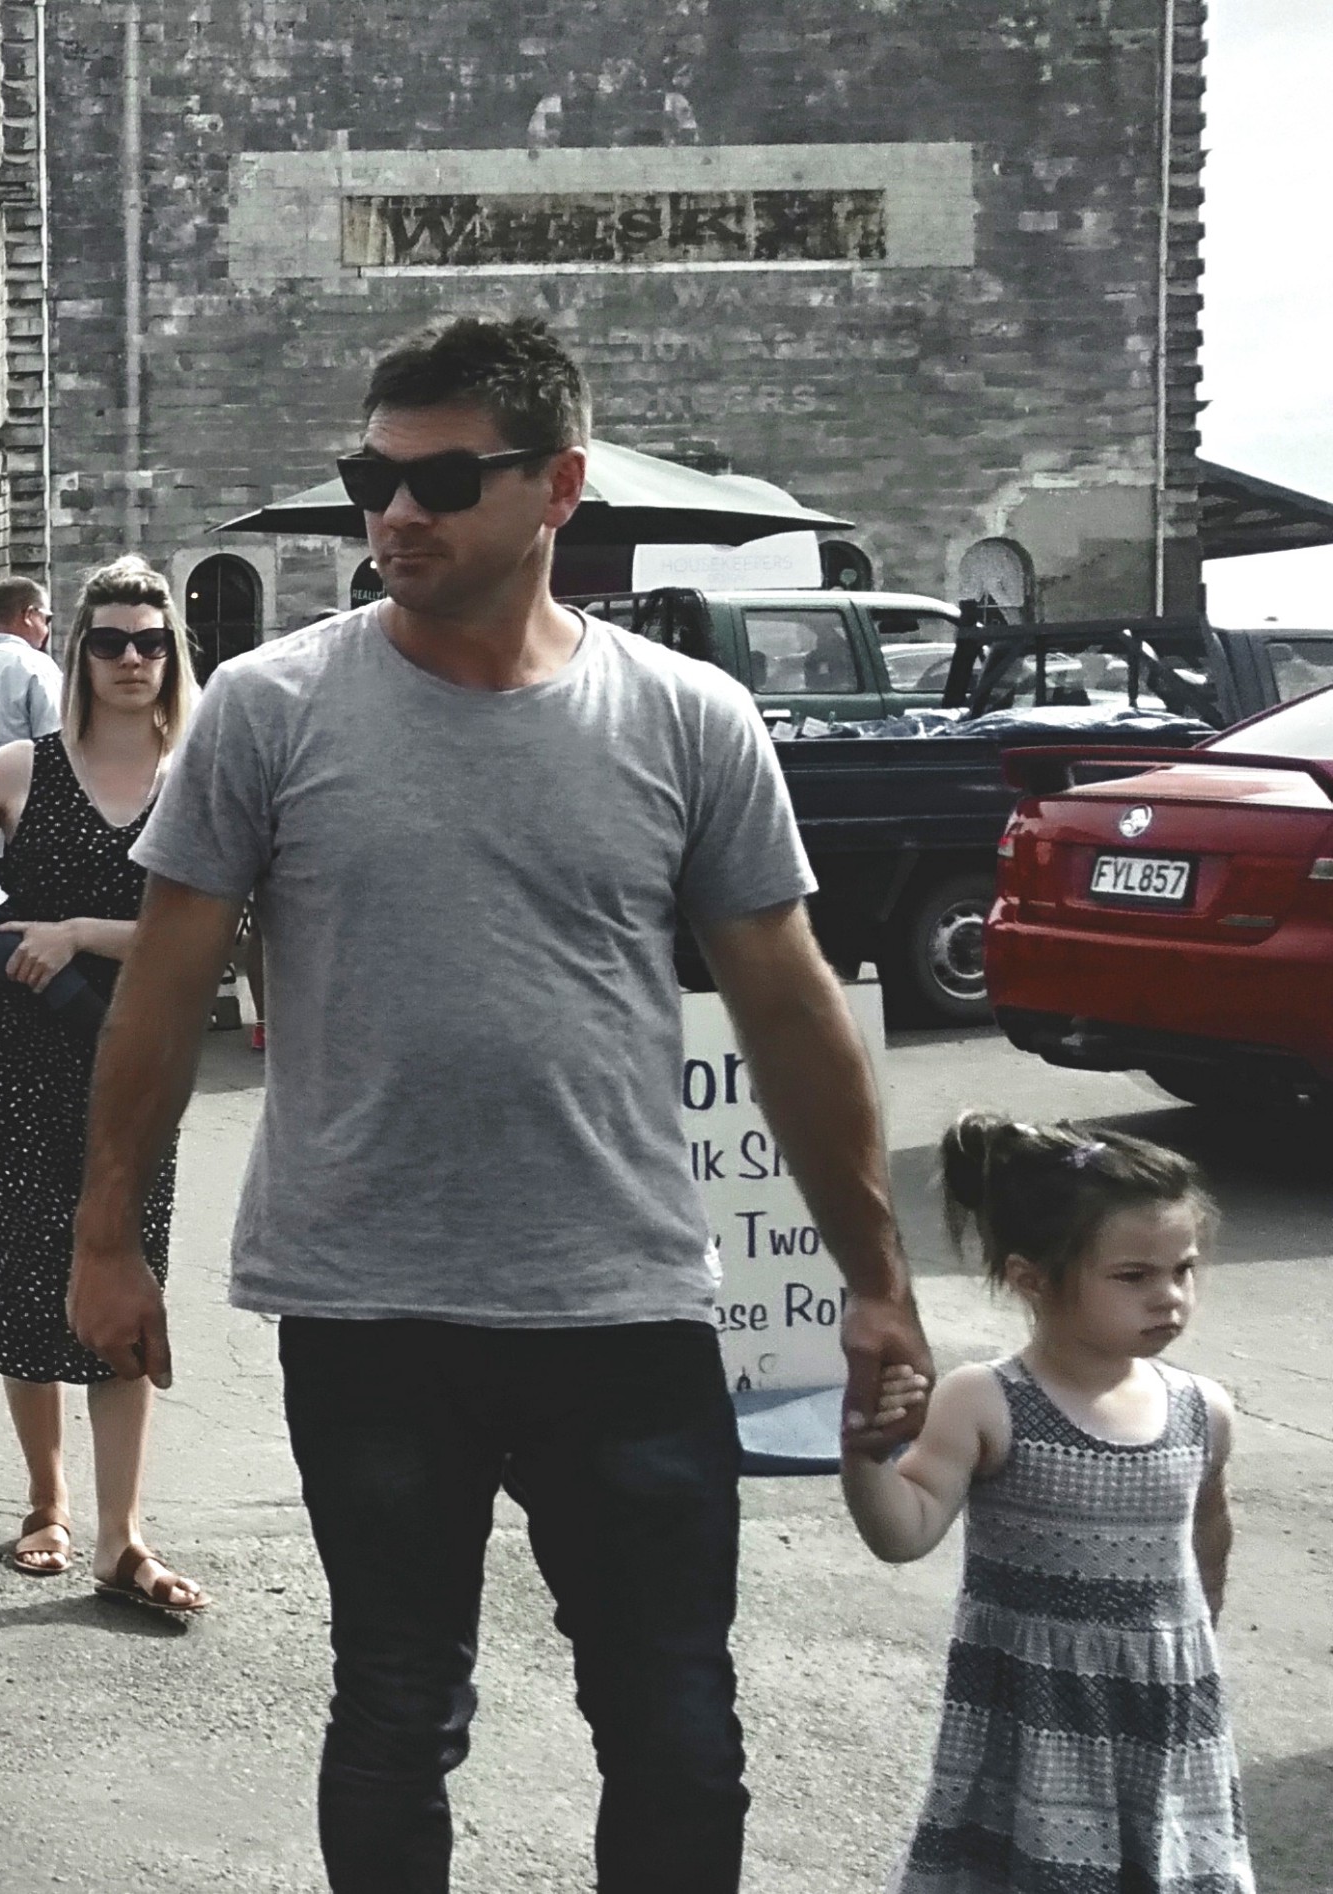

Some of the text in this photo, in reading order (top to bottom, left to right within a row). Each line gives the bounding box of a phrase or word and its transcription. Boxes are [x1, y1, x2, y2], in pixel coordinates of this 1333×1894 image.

[661, 554, 794, 574] HOUSEKEEPERS
[1094, 859, 1187, 895] FYL857
[734, 1210, 819, 1258] Two
